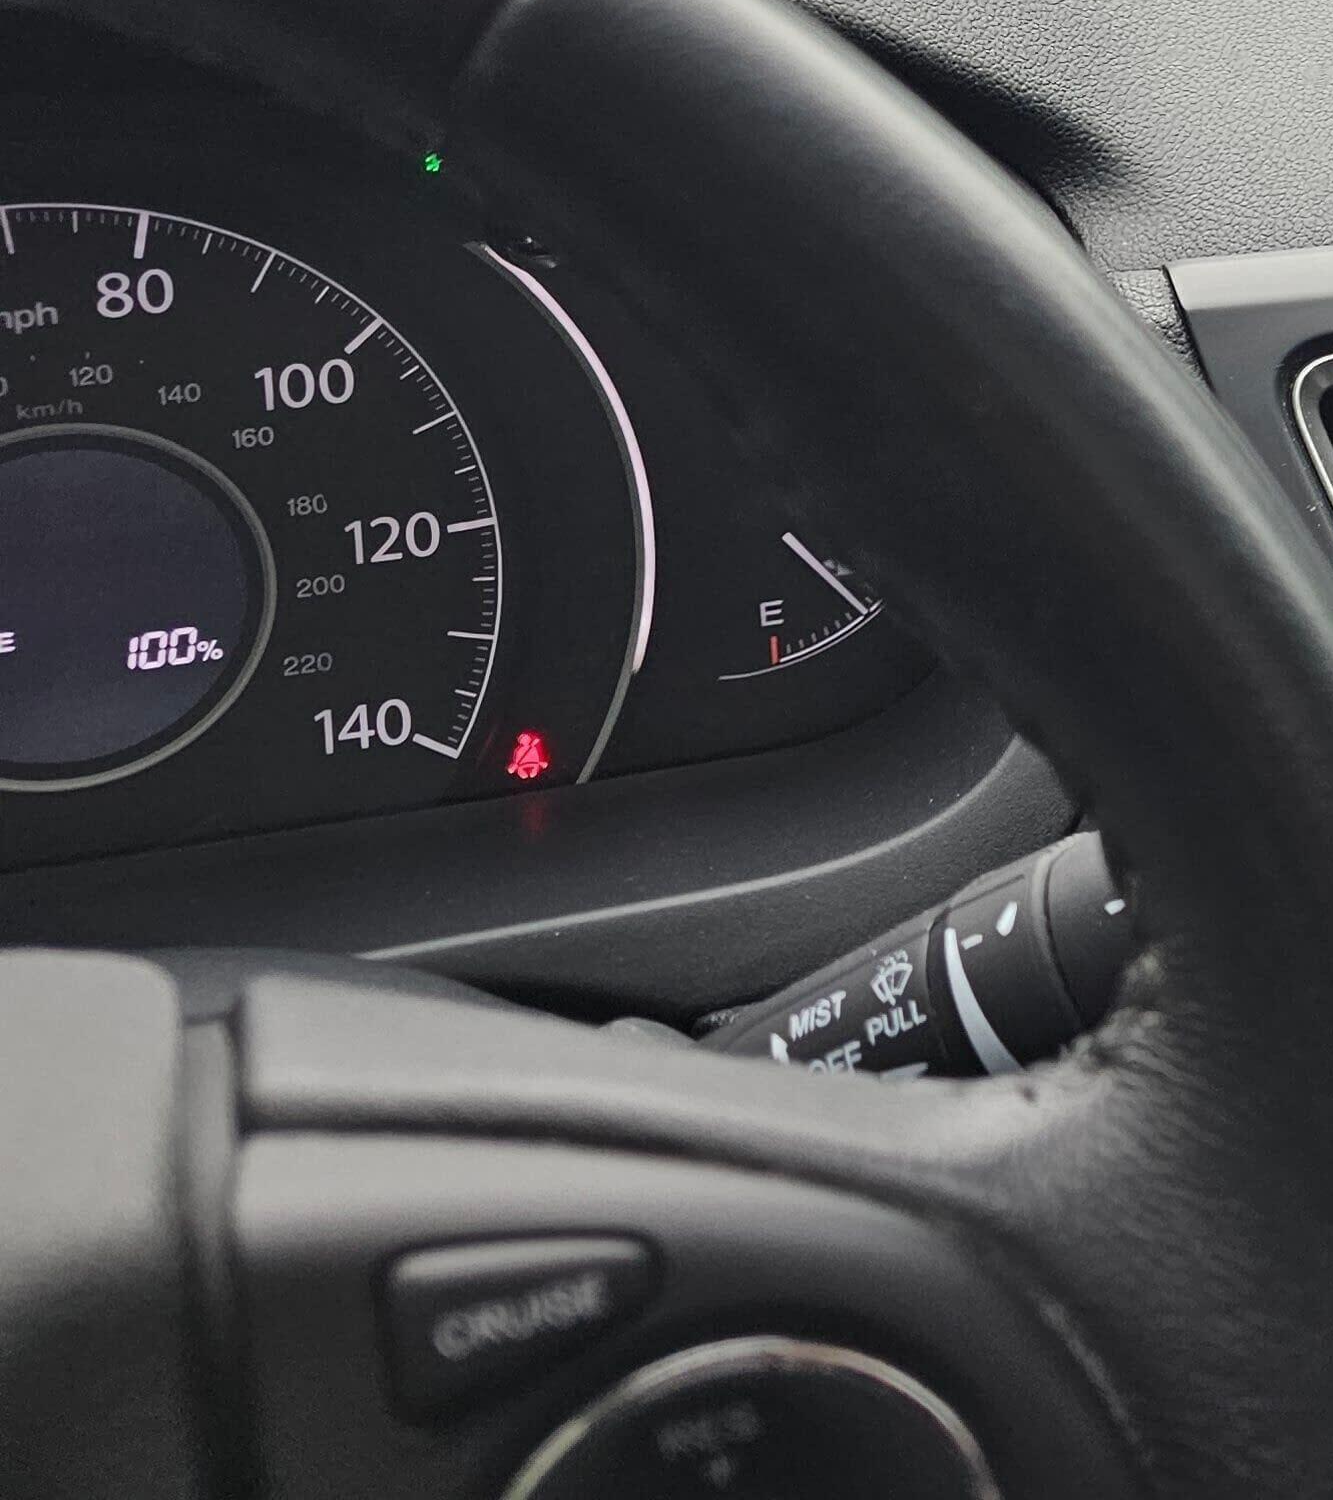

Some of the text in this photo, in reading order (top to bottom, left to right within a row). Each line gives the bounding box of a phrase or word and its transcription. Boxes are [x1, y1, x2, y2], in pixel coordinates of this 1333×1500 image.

[96, 268, 174, 318] 80
[69, 364, 113, 387] 120
[254, 358, 355, 411] 100
[158, 383, 201, 406] 140
[16, 399, 83, 420] km/h
[232, 427, 274, 449] 160
[287, 494, 328, 516] 180
[344, 511, 441, 564] 120
[296, 574, 346, 598] 200
[760, 600, 784, 627] E
[126, 626, 224, 671] 100%
[283, 653, 333, 676] 220
[313, 699, 412, 755] 140
[788, 990, 847, 1041] MIST
[865, 1000, 928, 1046] PULL
